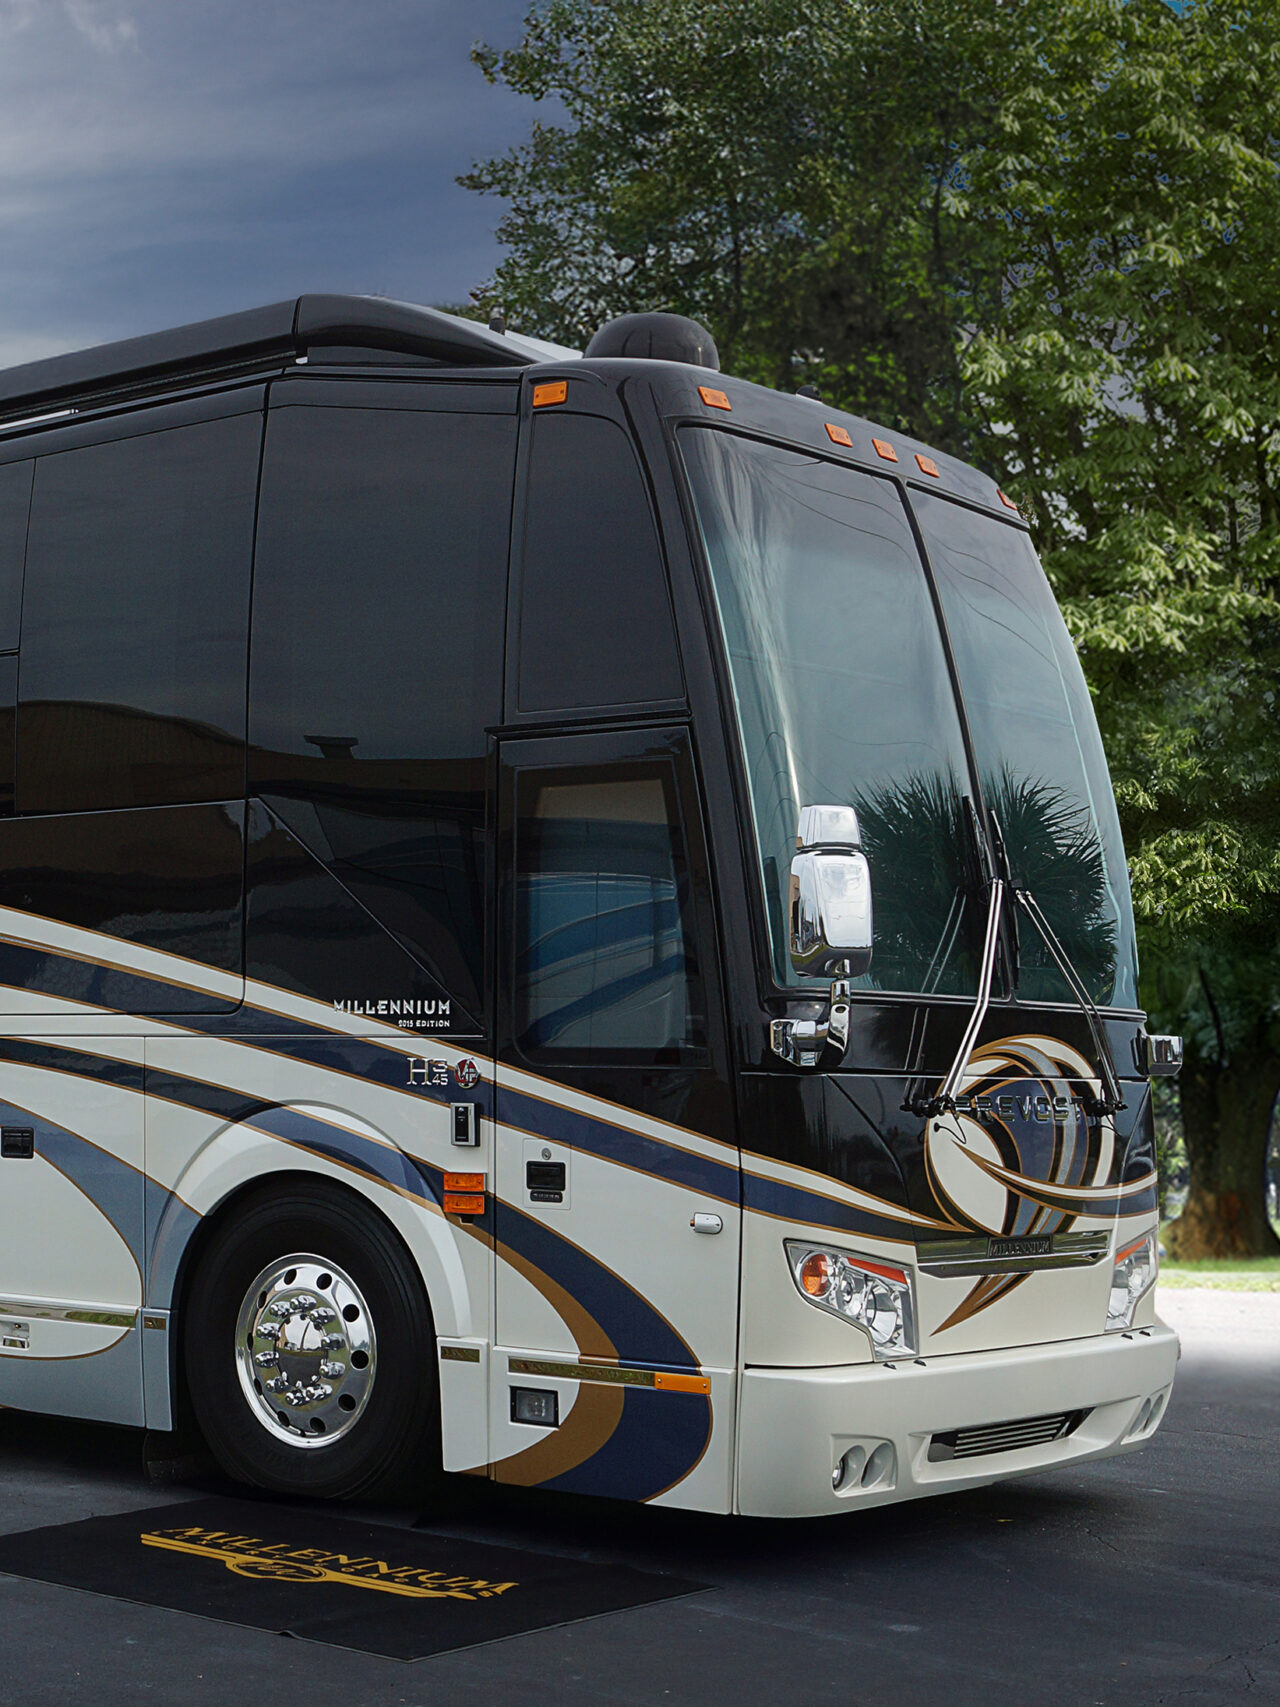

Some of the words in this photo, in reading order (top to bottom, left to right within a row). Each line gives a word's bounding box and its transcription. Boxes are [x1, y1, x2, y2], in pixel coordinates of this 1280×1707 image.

[333, 999, 451, 1015] MILLENNIUM
[416, 1020, 451, 1028] EDITION
[953, 1095, 1084, 1122] PREVOST
[989, 1240, 1051, 1257] MILLENNIUM
[162, 1527, 520, 1594] MILLENNIUM
